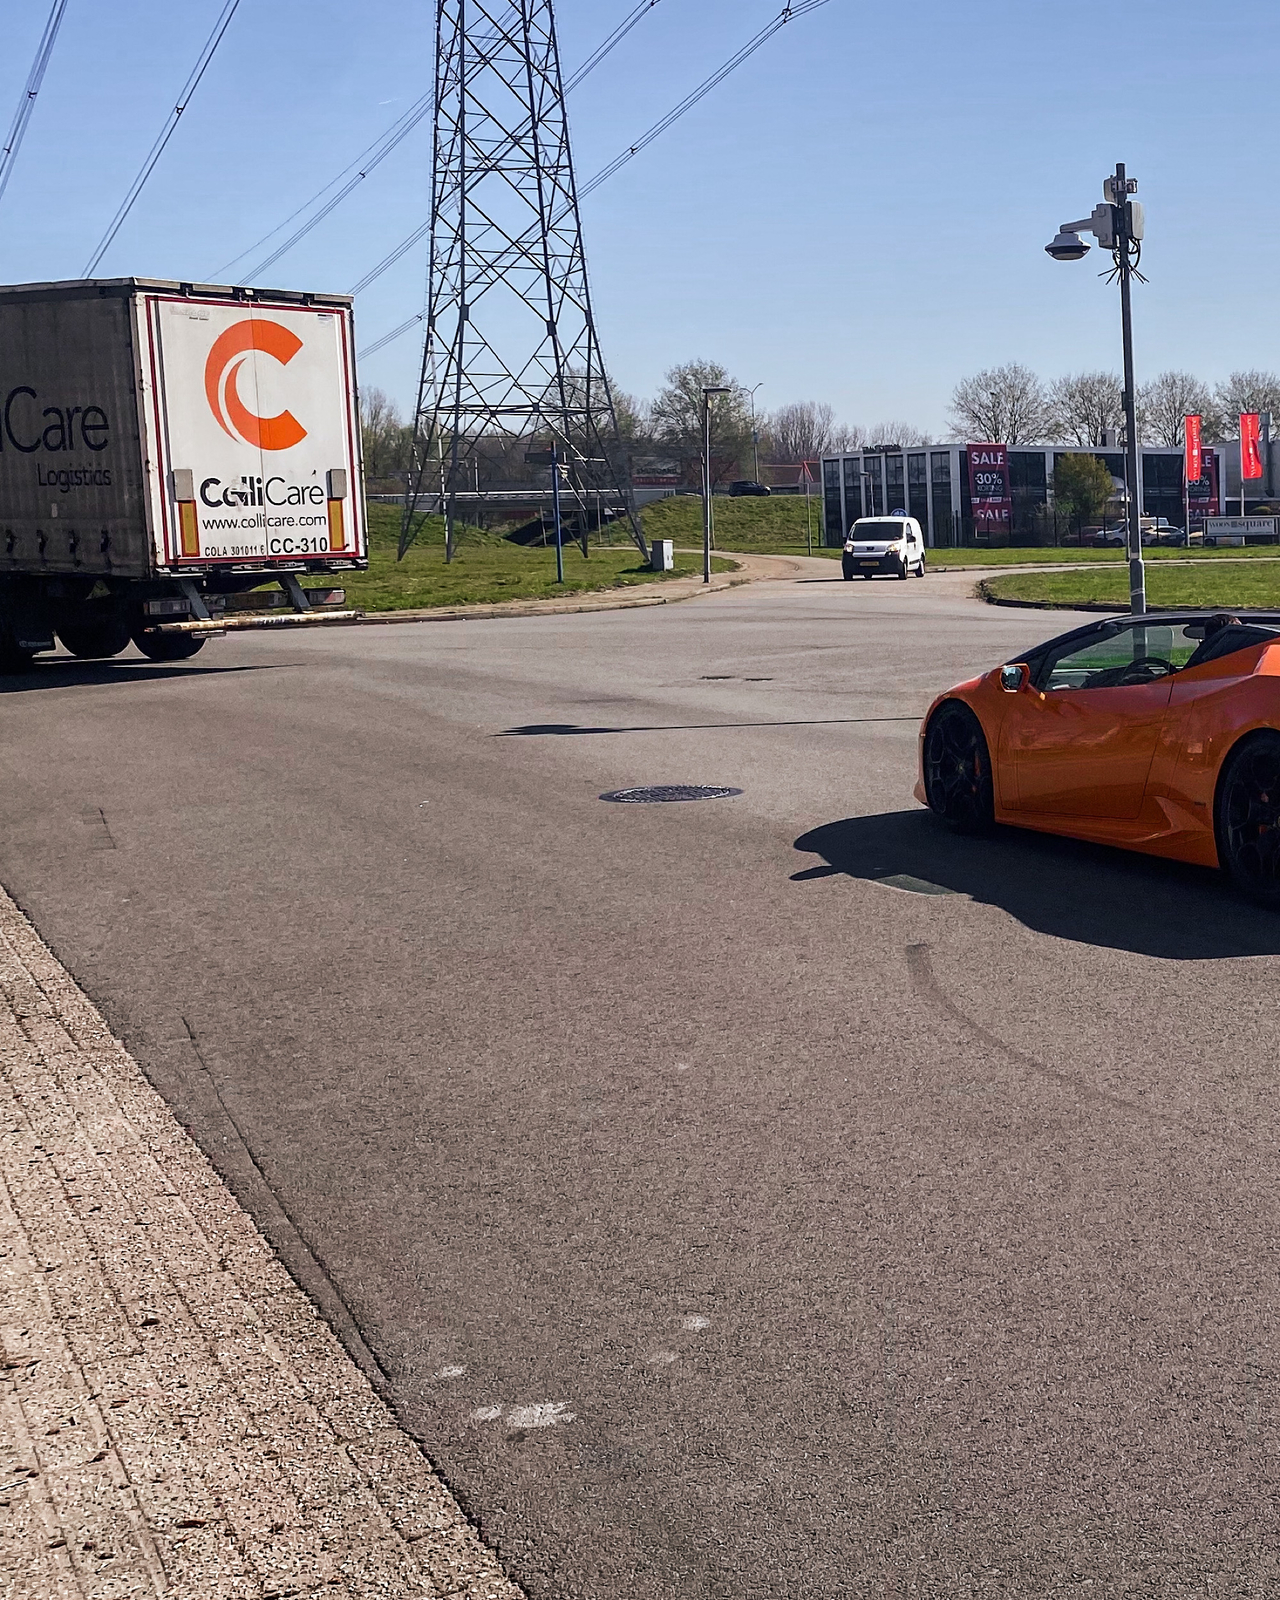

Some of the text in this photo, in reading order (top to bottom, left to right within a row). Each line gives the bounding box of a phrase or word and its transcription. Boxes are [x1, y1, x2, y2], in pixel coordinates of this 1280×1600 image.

[971, 451, 1004, 465] SALE
[37, 462, 112, 493] Logistics
[202, 513, 327, 530] www.collicare.com
[976, 508, 1009, 522] SALE
[1237, 519, 1273, 531] square
[204, 546, 228, 557] COLA
[270, 537, 328, 554] CC-310
